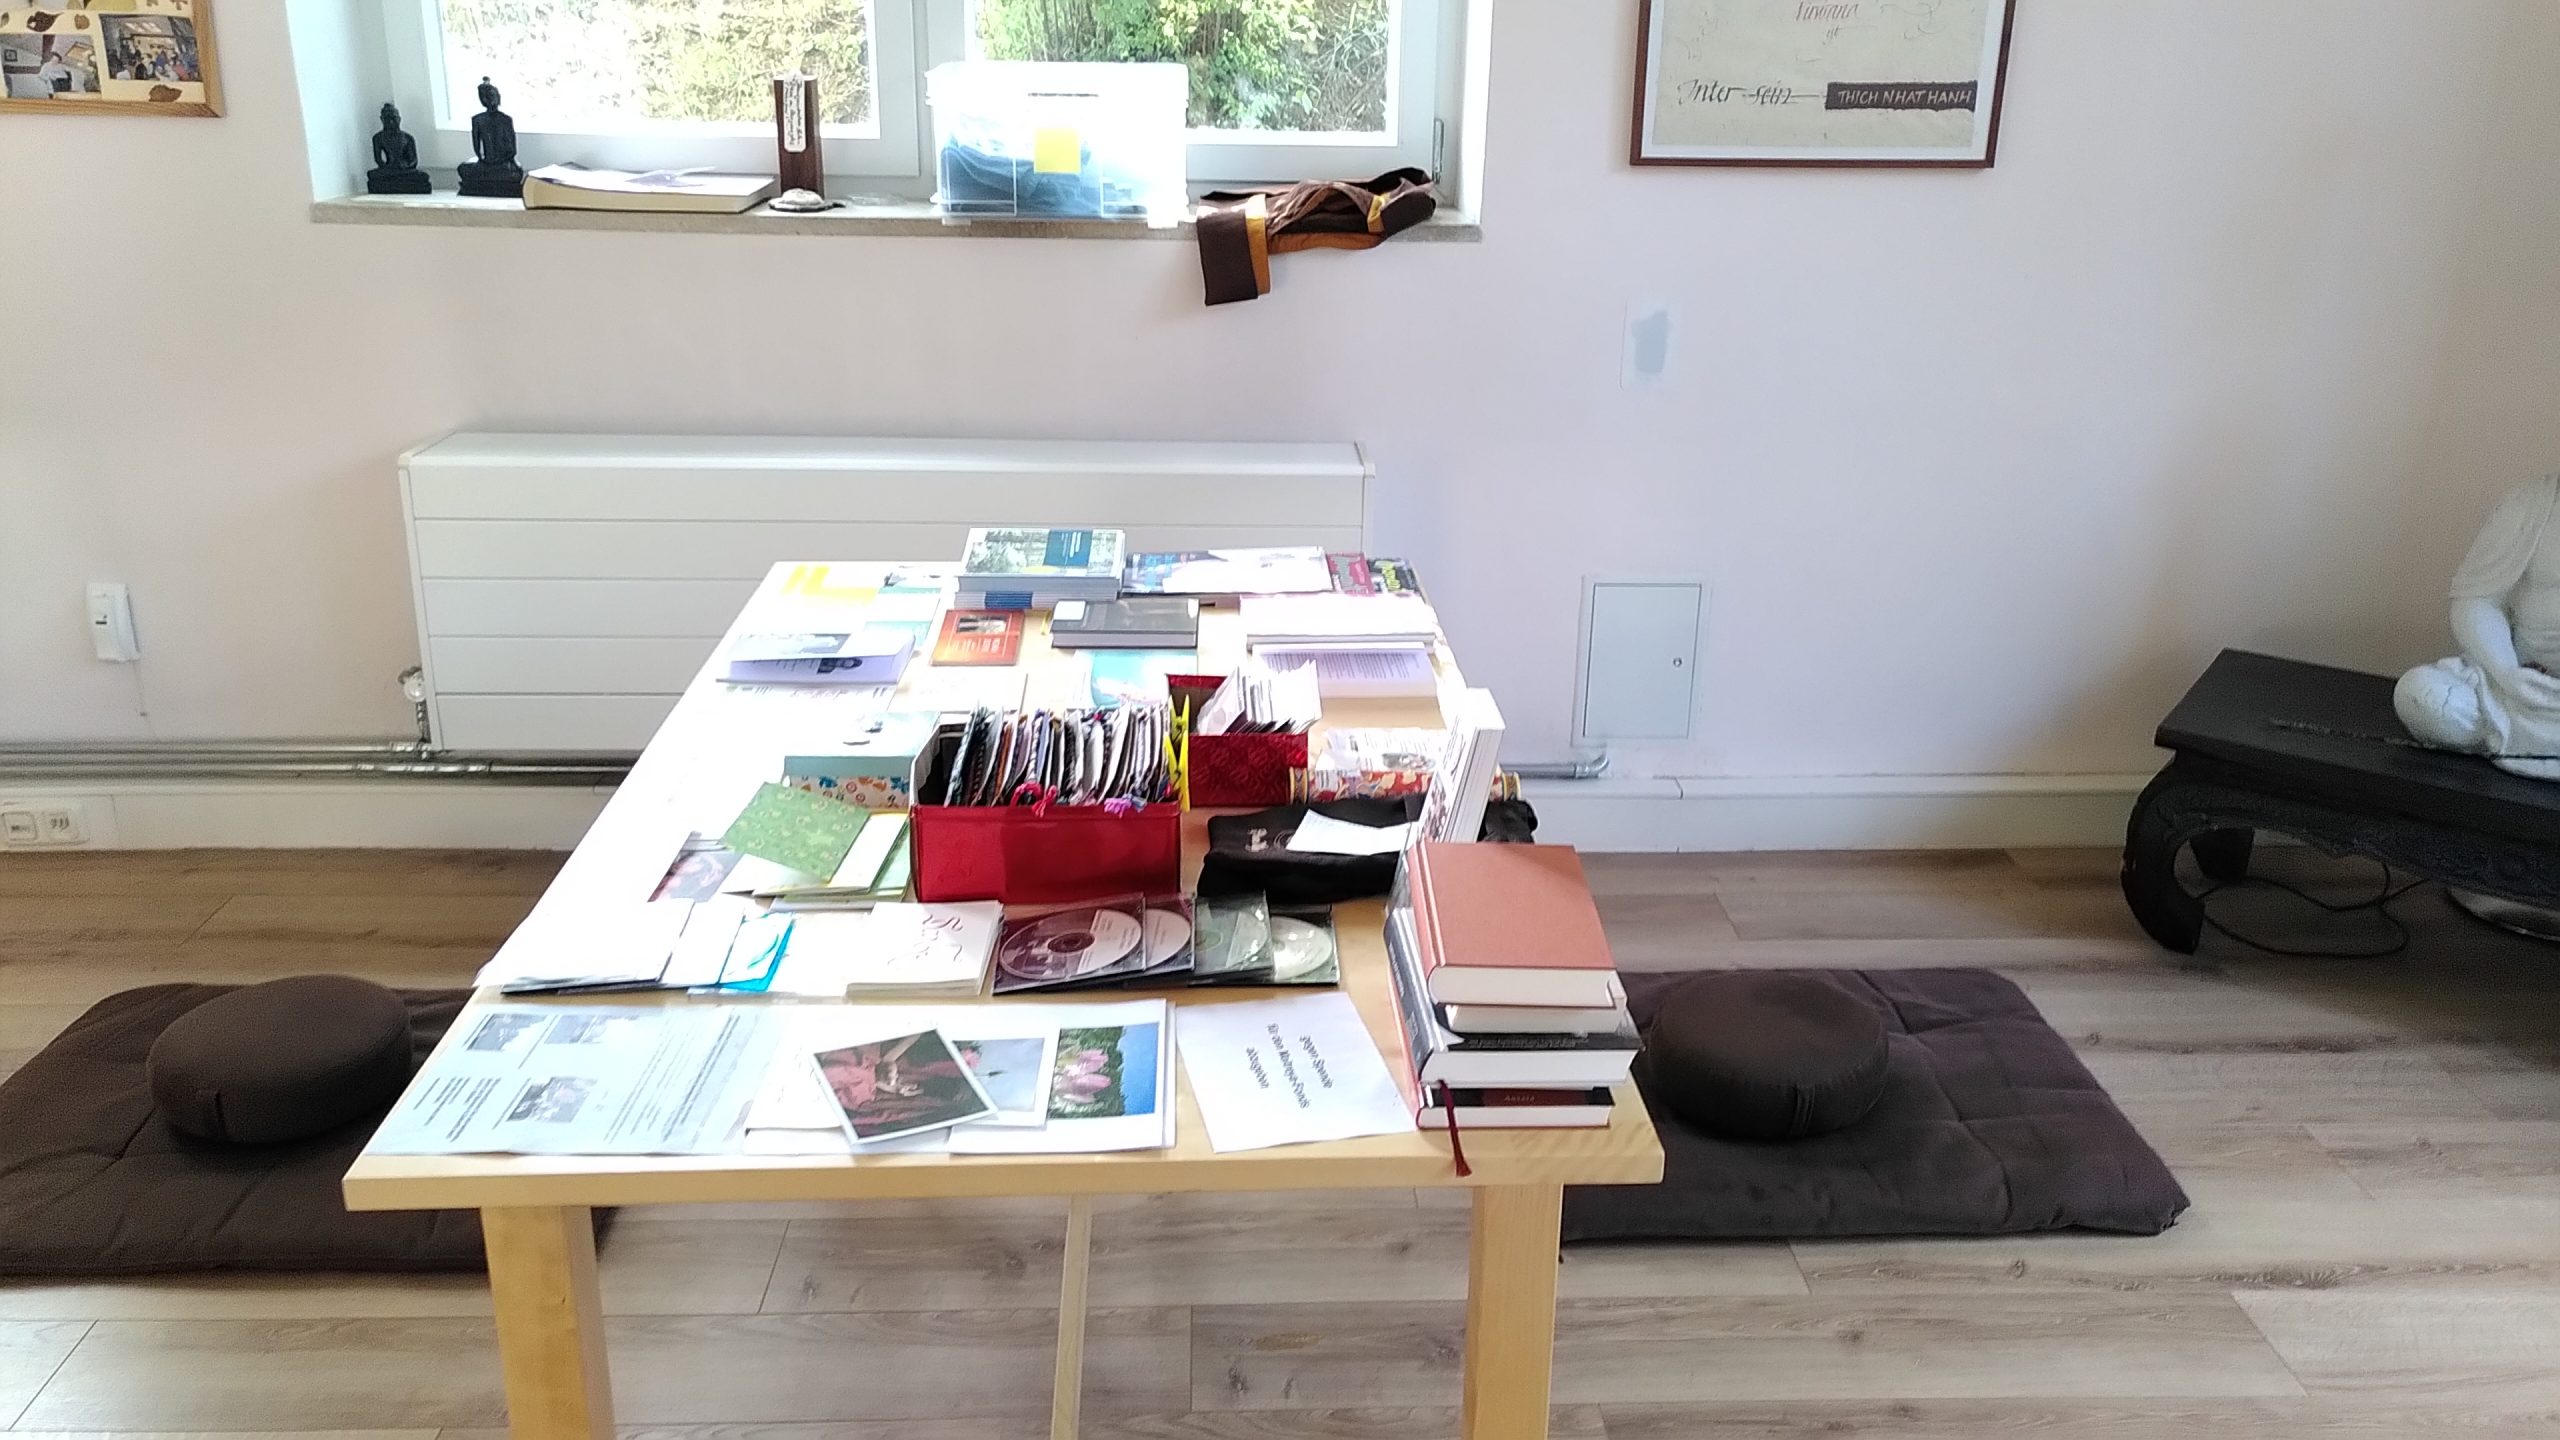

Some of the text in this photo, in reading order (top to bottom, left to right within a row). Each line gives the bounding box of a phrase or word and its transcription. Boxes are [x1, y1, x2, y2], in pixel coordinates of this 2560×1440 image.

[1837, 88, 1973, 105] THICH NHAT HANH
